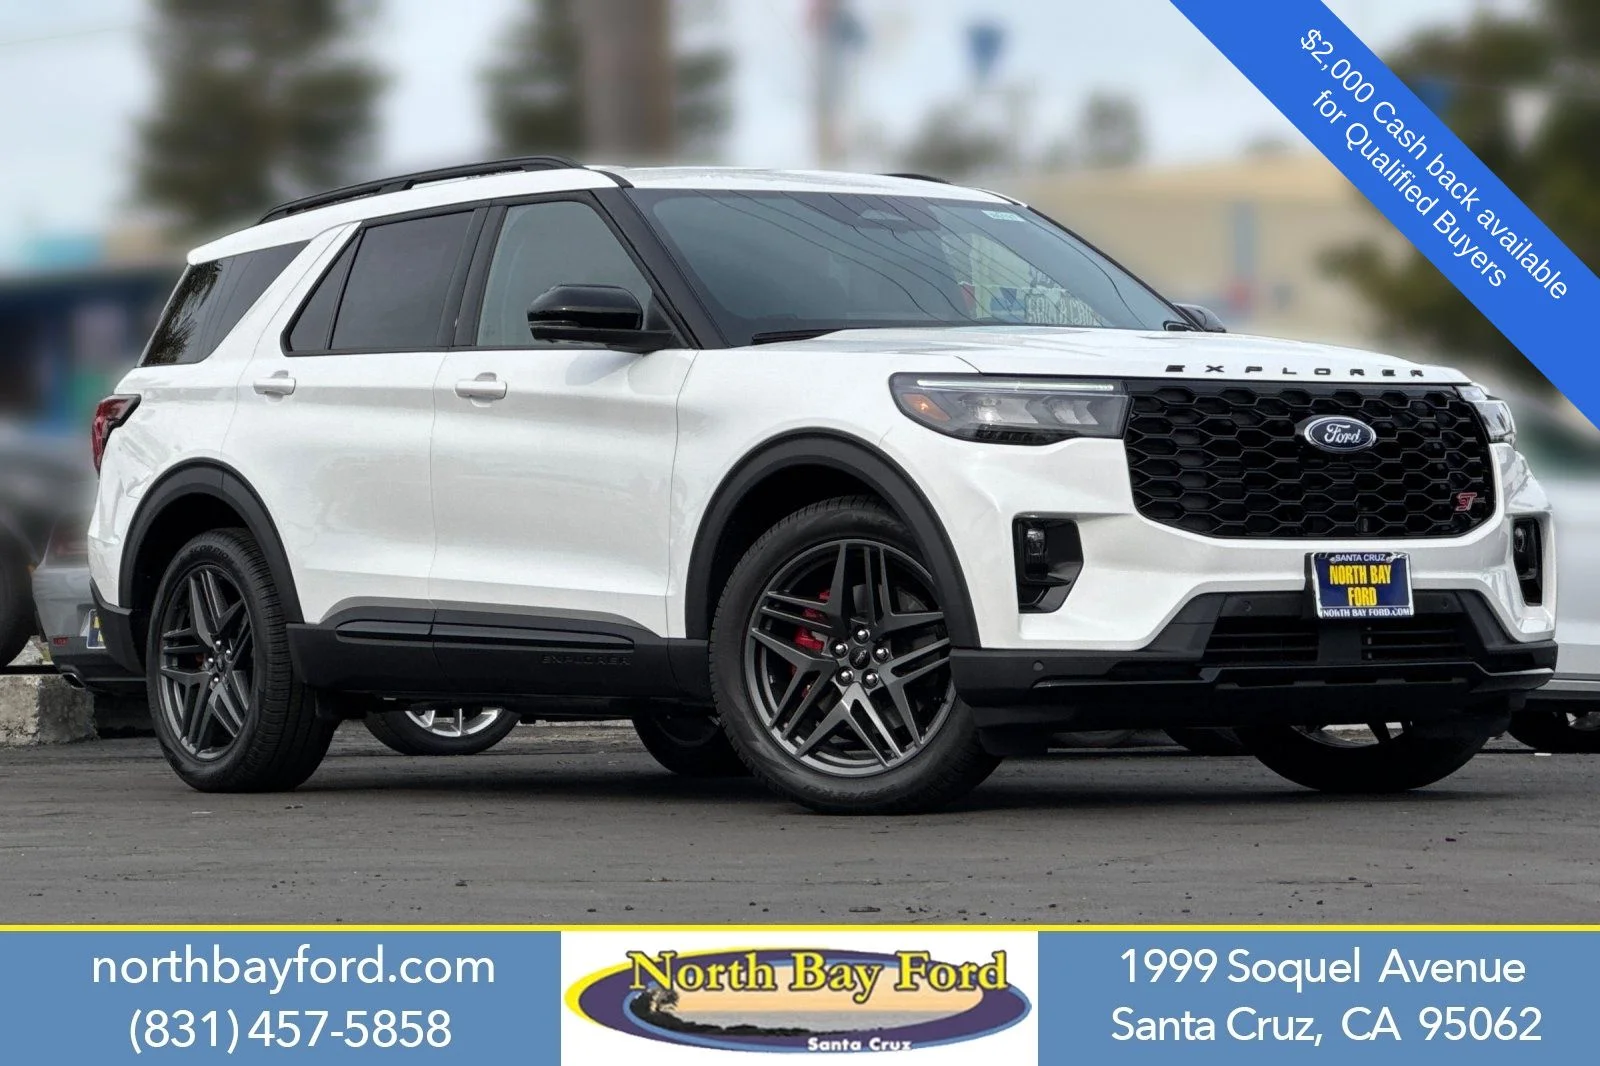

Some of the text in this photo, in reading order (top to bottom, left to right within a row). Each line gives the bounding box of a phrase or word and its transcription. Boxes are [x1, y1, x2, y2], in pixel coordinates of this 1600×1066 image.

[1165, 364, 1425, 379] EXPLORER
[1324, 423, 1361, 443] Ford
[1335, 554, 1362, 562] SANTA
[1330, 565, 1391, 585] NORTH BAY
[1348, 587, 1377, 607] FORD
[1323, 608, 1410, 617] NORTH BAY FORD.COM
